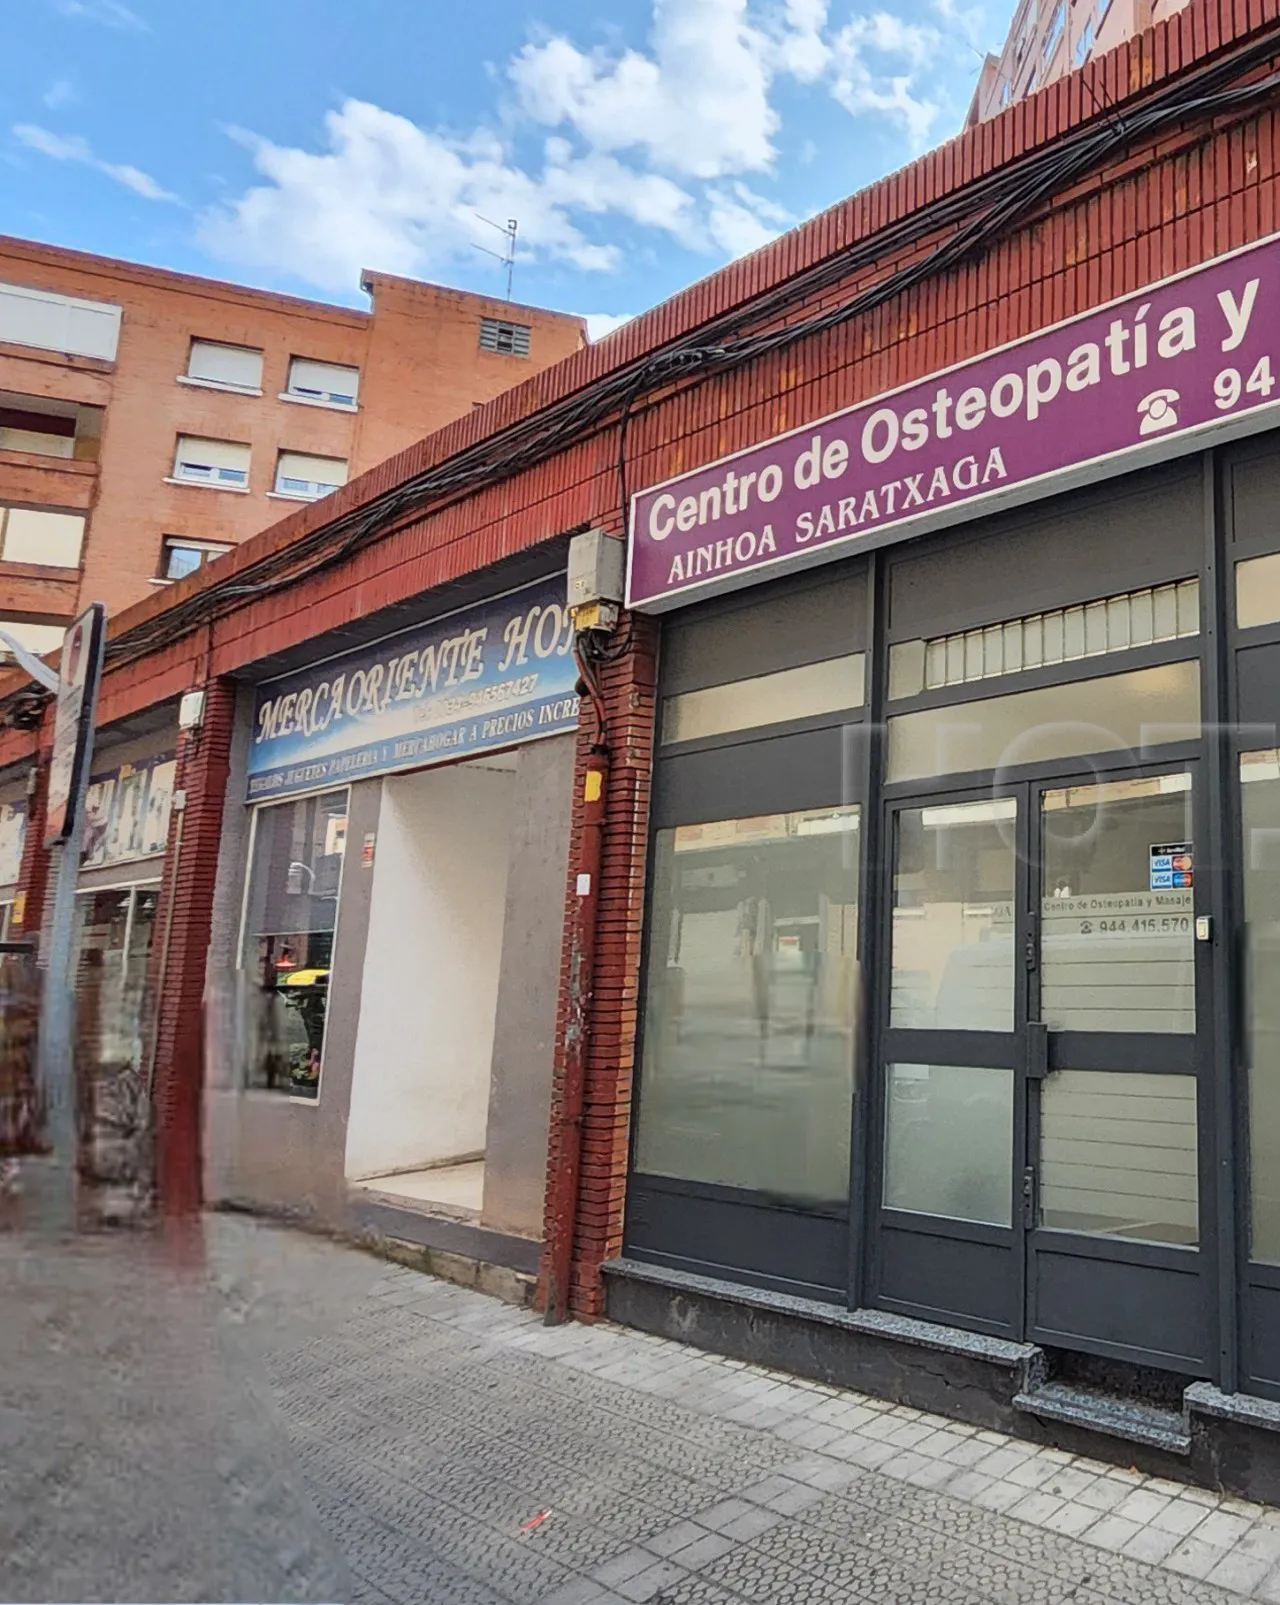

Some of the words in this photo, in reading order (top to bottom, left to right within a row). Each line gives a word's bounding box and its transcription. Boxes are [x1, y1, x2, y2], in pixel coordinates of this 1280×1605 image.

[649, 464, 783, 541] Centro
[793, 436, 849, 490] de
[861, 302, 1197, 465] Osteopatía
[1217, 278, 1260, 352] y
[667, 530, 777, 585] AINHOA
[794, 446, 1008, 544] SARATXAGA
[256, 627, 489, 744] MERCAORIENTE
[481, 708, 535, 739] PRECIOS
[1154, 858, 1170, 867] VISA
[1154, 875, 1171, 884] VISA
[1077, 900, 1088, 910] de
[1146, 899, 1153, 909] y
[1155, 895, 1192, 909] Masaje
